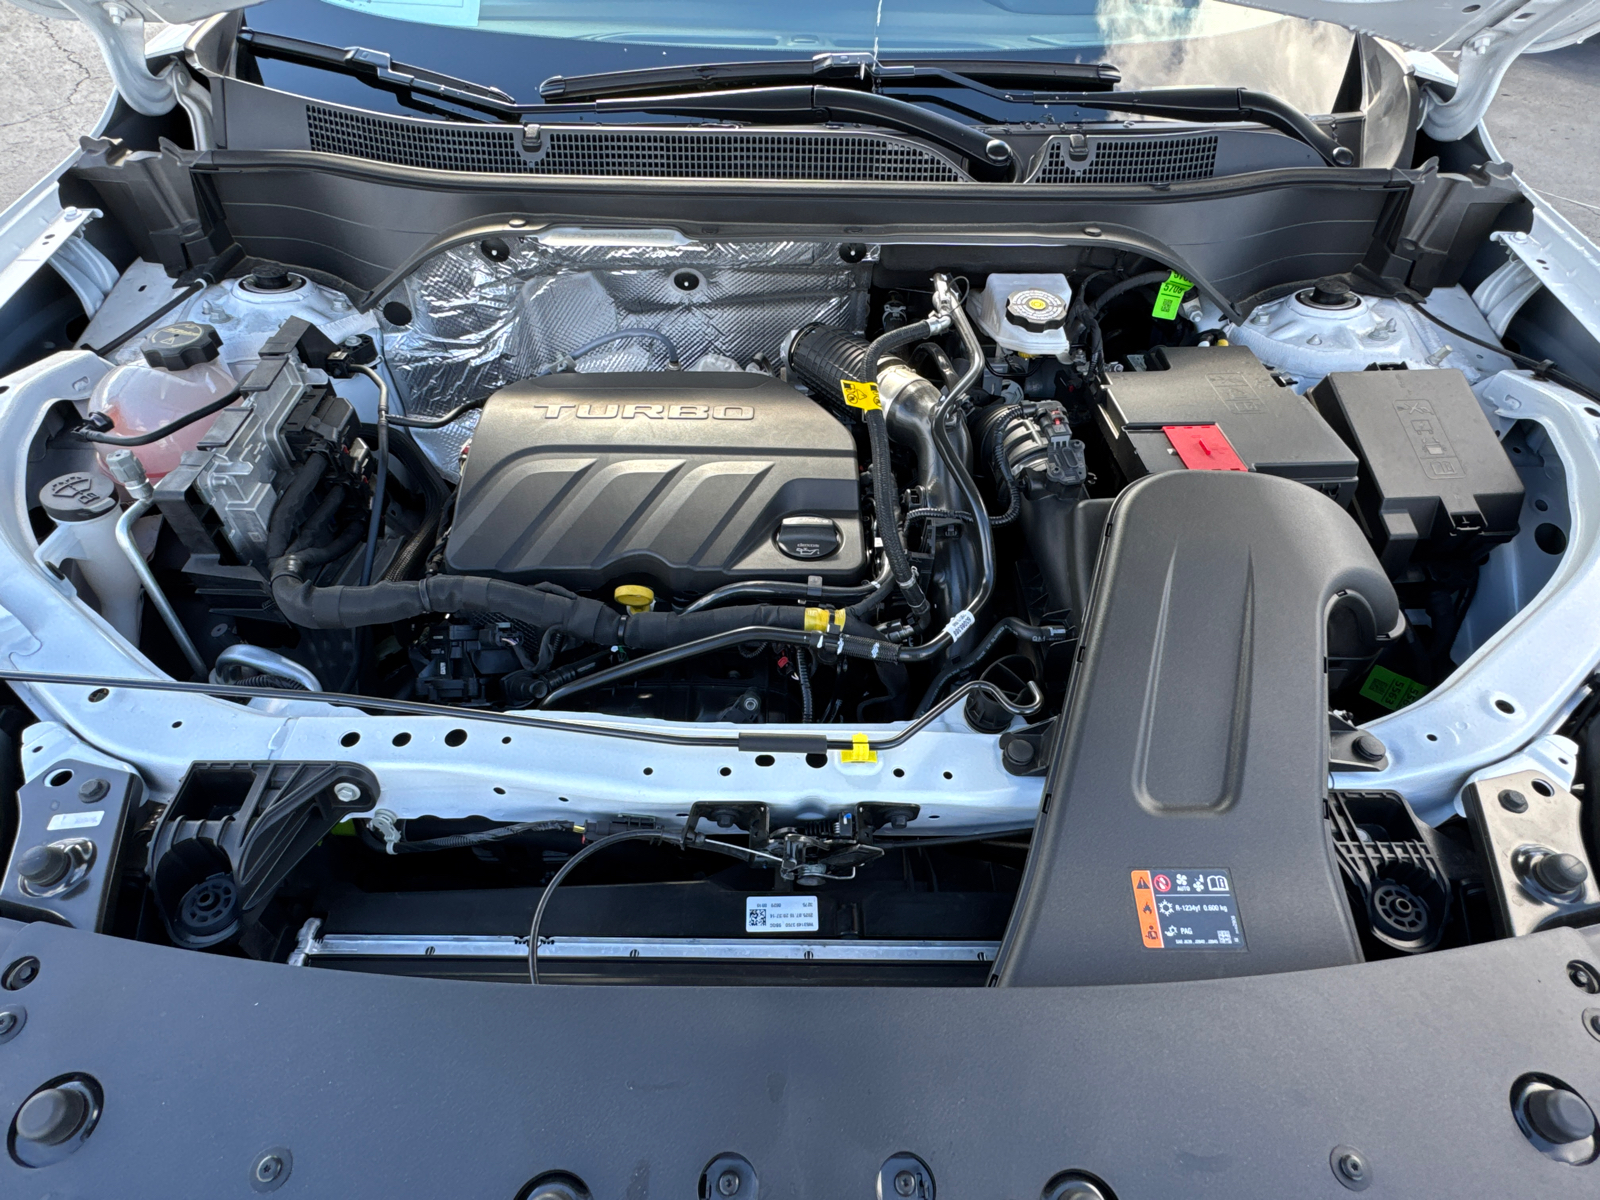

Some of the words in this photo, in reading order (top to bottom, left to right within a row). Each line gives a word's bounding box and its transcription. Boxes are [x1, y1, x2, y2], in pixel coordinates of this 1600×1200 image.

[533, 402, 755, 420] TURBO
[1385, 681, 1405, 705] 5563
[1175, 904, 1201, 913] R-1234yf
[1219, 904, 1228, 913] kg
[1179, 927, 1193, 935] PAG
